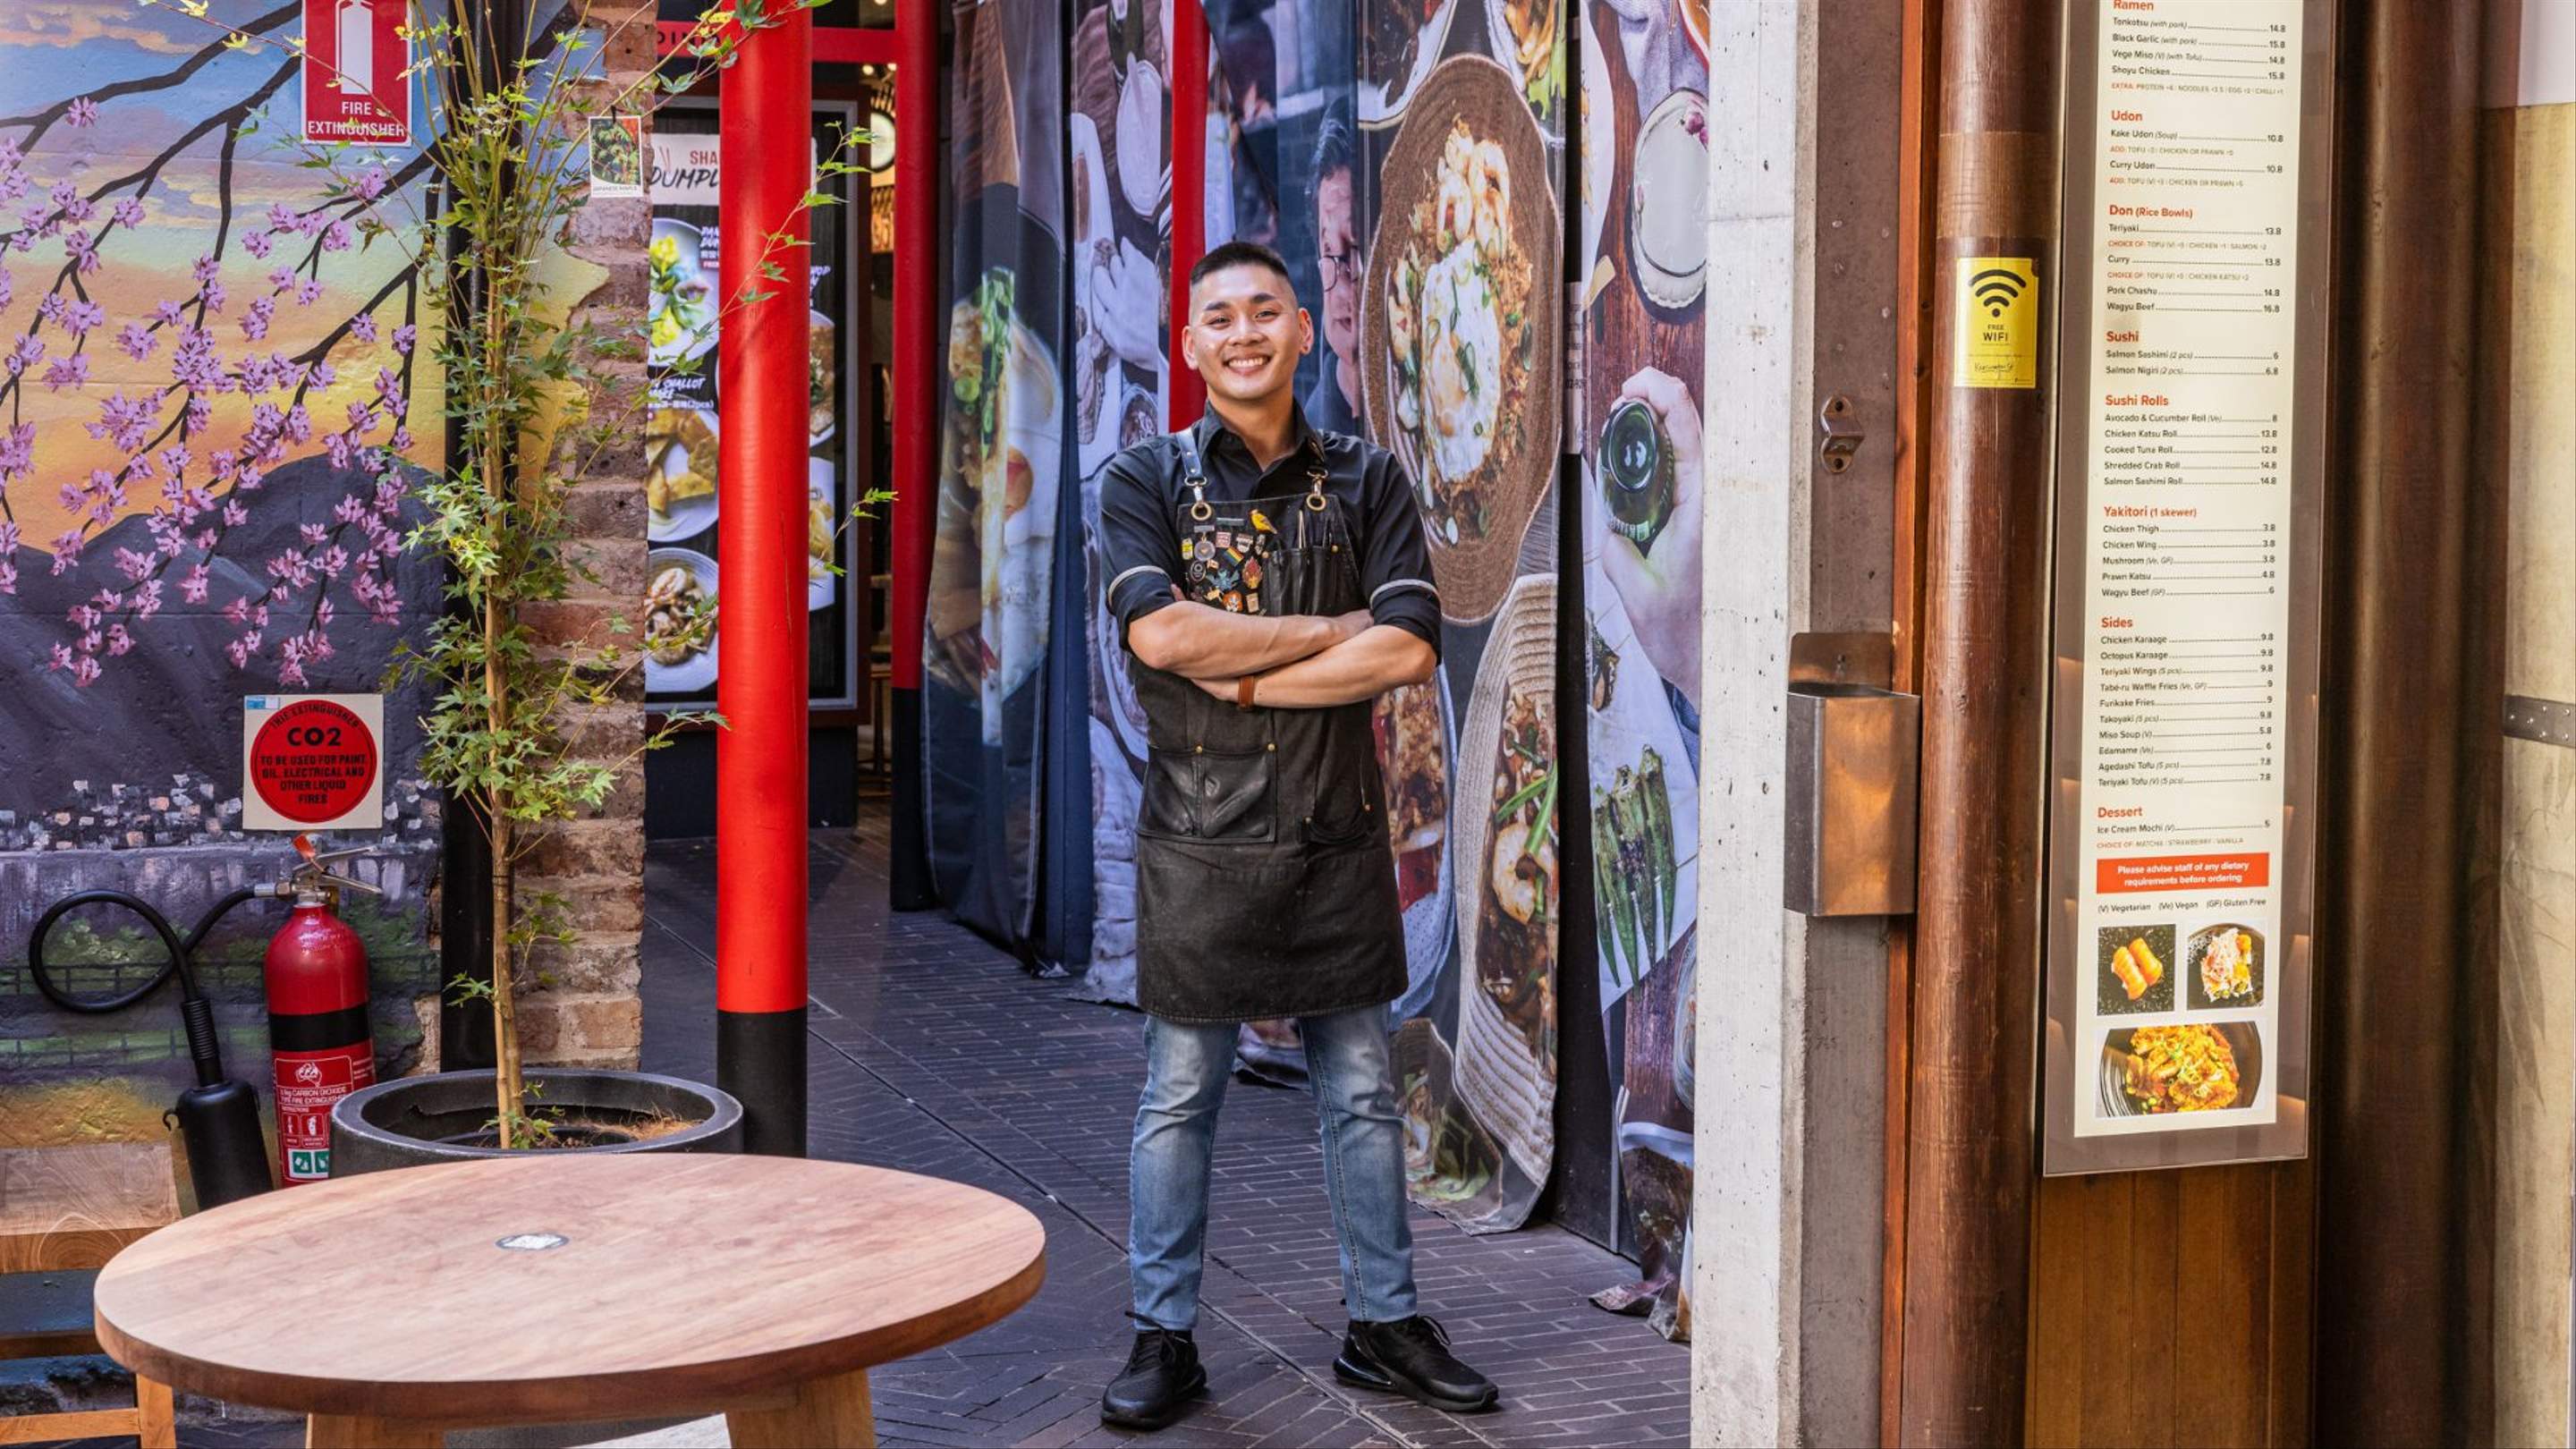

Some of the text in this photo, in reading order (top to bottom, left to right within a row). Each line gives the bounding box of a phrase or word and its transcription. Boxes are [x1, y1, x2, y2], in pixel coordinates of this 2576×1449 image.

[2114, 0, 2154, 11] Ramen
[2114, 18, 2148, 27] Tonkotsu
[2113, 34, 2133, 42] Black
[2137, 35, 2159, 43] Garlic
[2112, 50, 2132, 59] Vege
[2135, 52, 2153, 60] Miso
[2112, 66, 2136, 75] Shoyu
[2140, 67, 2170, 75] Chicken
[341, 101, 372, 115] FIRE
[2112, 111, 2142, 122] Udon
[307, 120, 405, 136] EXTINGUISHER
[2110, 161, 2131, 170] Curry
[2109, 205, 2192, 218] Don (Rice Bowls)
[2109, 225, 2139, 233] Teriyaki
[2108, 256, 2130, 265] Curry
[2128, 287, 2157, 295] Chashu
[2107, 303, 2134, 311] Wagyu
[1983, 332, 2008, 341] WIFI
[2106, 331, 2139, 343] Sushi
[2106, 351, 2135, 359] Salmon
[2106, 367, 2135, 375] Salmon
[2138, 367, 2158, 376] Nigiri
[2106, 395, 2168, 406] Sushi Rolls
[2105, 414, 2139, 422] Avocado
[2149, 414, 2189, 422] Cucumber
[2105, 462, 2141, 470] Shredded
[2145, 462, 2163, 470] Crab
[2105, 478, 2133, 486] Salmon
[2104, 506, 2148, 517] Yakitori
[2161, 508, 2197, 517] skewer)
[2104, 525, 2135, 533] Chicken
[2138, 525, 2159, 534] Thigh
[2137, 541, 2157, 549] Wing
[2102, 589, 2128, 597] Wagyu
[2102, 617, 2132, 628] Sides
[2101, 636, 2132, 644] Chicken
[2135, 636, 2166, 645] Karaage
[2100, 652, 2133, 660] Octopus
[2136, 652, 2168, 660] Karaage
[2101, 667, 2131, 676] Teriyaki
[2132, 667, 2157, 676] Wings
[2132, 682, 2157, 691] Waffle
[2100, 699, 2133, 708] Furikake
[2100, 716, 2134, 724] Takoyaki
[287, 727, 342, 746] CO2
[2120, 732, 2140, 740] Soup
[261, 756, 273, 766] TO
[275, 756, 287, 765] BE
[291, 756, 315, 765] USED
[318, 756, 337, 764] FOR
[284, 768, 343, 777] ELECTRICAL
[346, 767, 364, 776] AND
[2098, 763, 2135, 772] Agedashi
[281, 781, 312, 791] OTHER
[2098, 779, 2129, 787] Teriyaki
[298, 793, 327, 803] FIRES
[2097, 807, 2142, 818] Dessert
[2111, 826, 2137, 834] Cream
[2140, 825, 2163, 833] Mochi
[2118, 866, 2144, 874] Please
[2147, 865, 2172, 873] advise
[2174, 864, 2191, 872] staff
[2204, 864, 2219, 872] any
[2221, 862, 2250, 872] dietary
[2124, 875, 2242, 887] requirements before ordering
[2111, 904, 2150, 913] Vegetarian
[2176, 902, 2198, 911] Vegan
